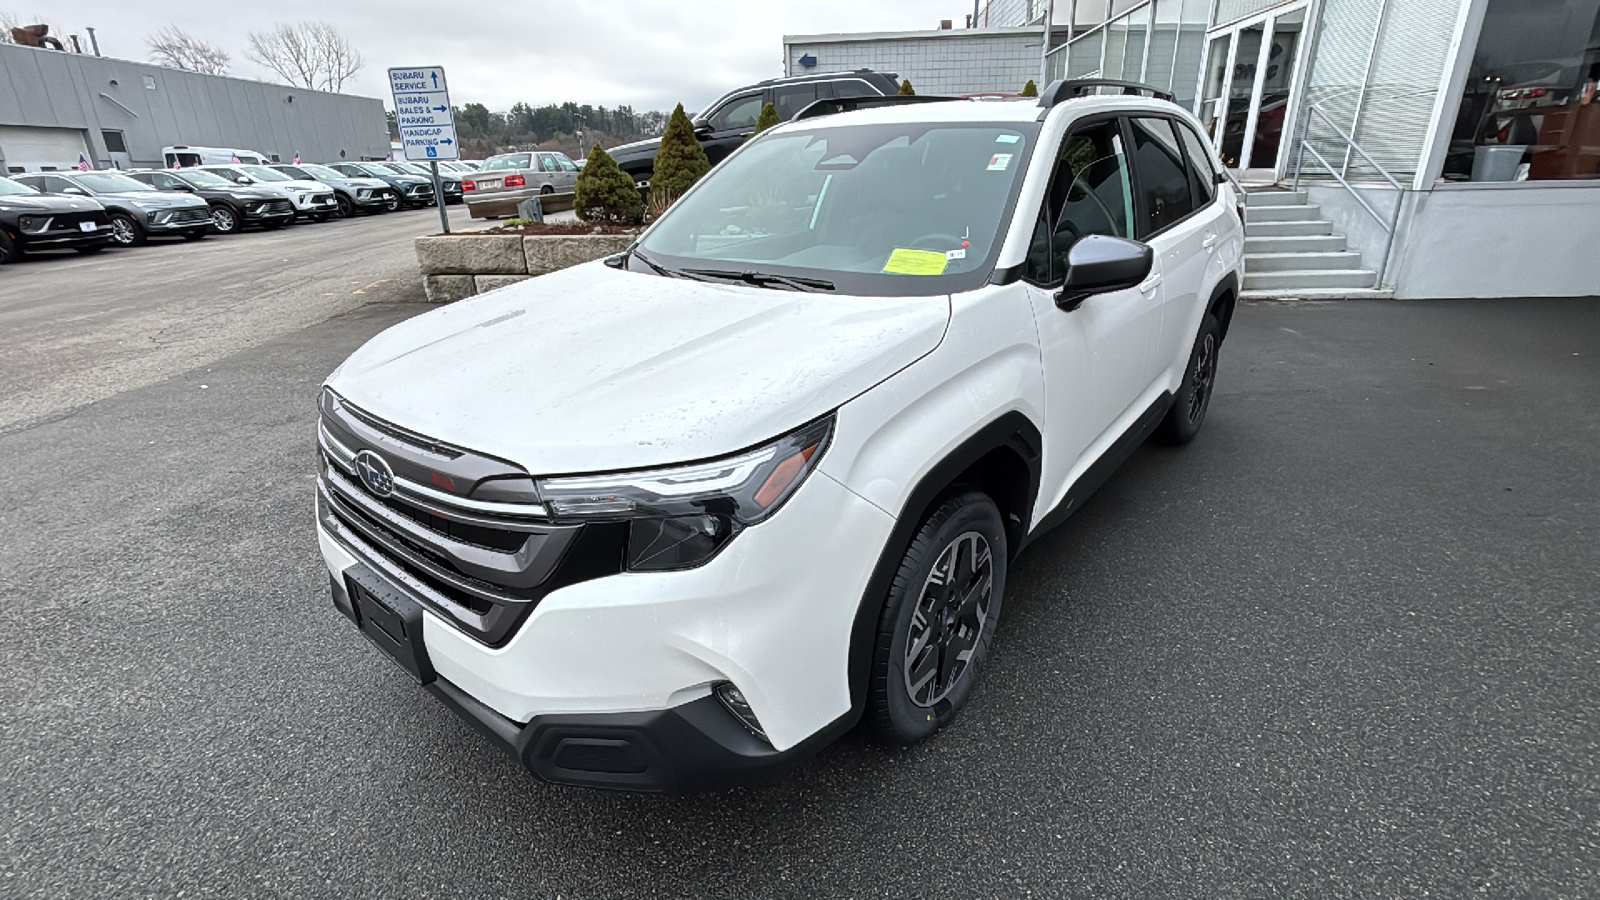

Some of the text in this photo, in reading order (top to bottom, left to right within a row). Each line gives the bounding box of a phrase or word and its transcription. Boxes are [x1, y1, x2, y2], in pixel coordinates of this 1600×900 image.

[392, 71, 424, 80] SUBARU
[394, 81, 427, 90] SERVICE
[397, 96, 429, 105] SUBARU
[400, 107, 424, 115] SALES
[401, 116, 435, 125] PARKING
[403, 128, 442, 137] HANDICAP
[405, 139, 439, 147] PARKING
